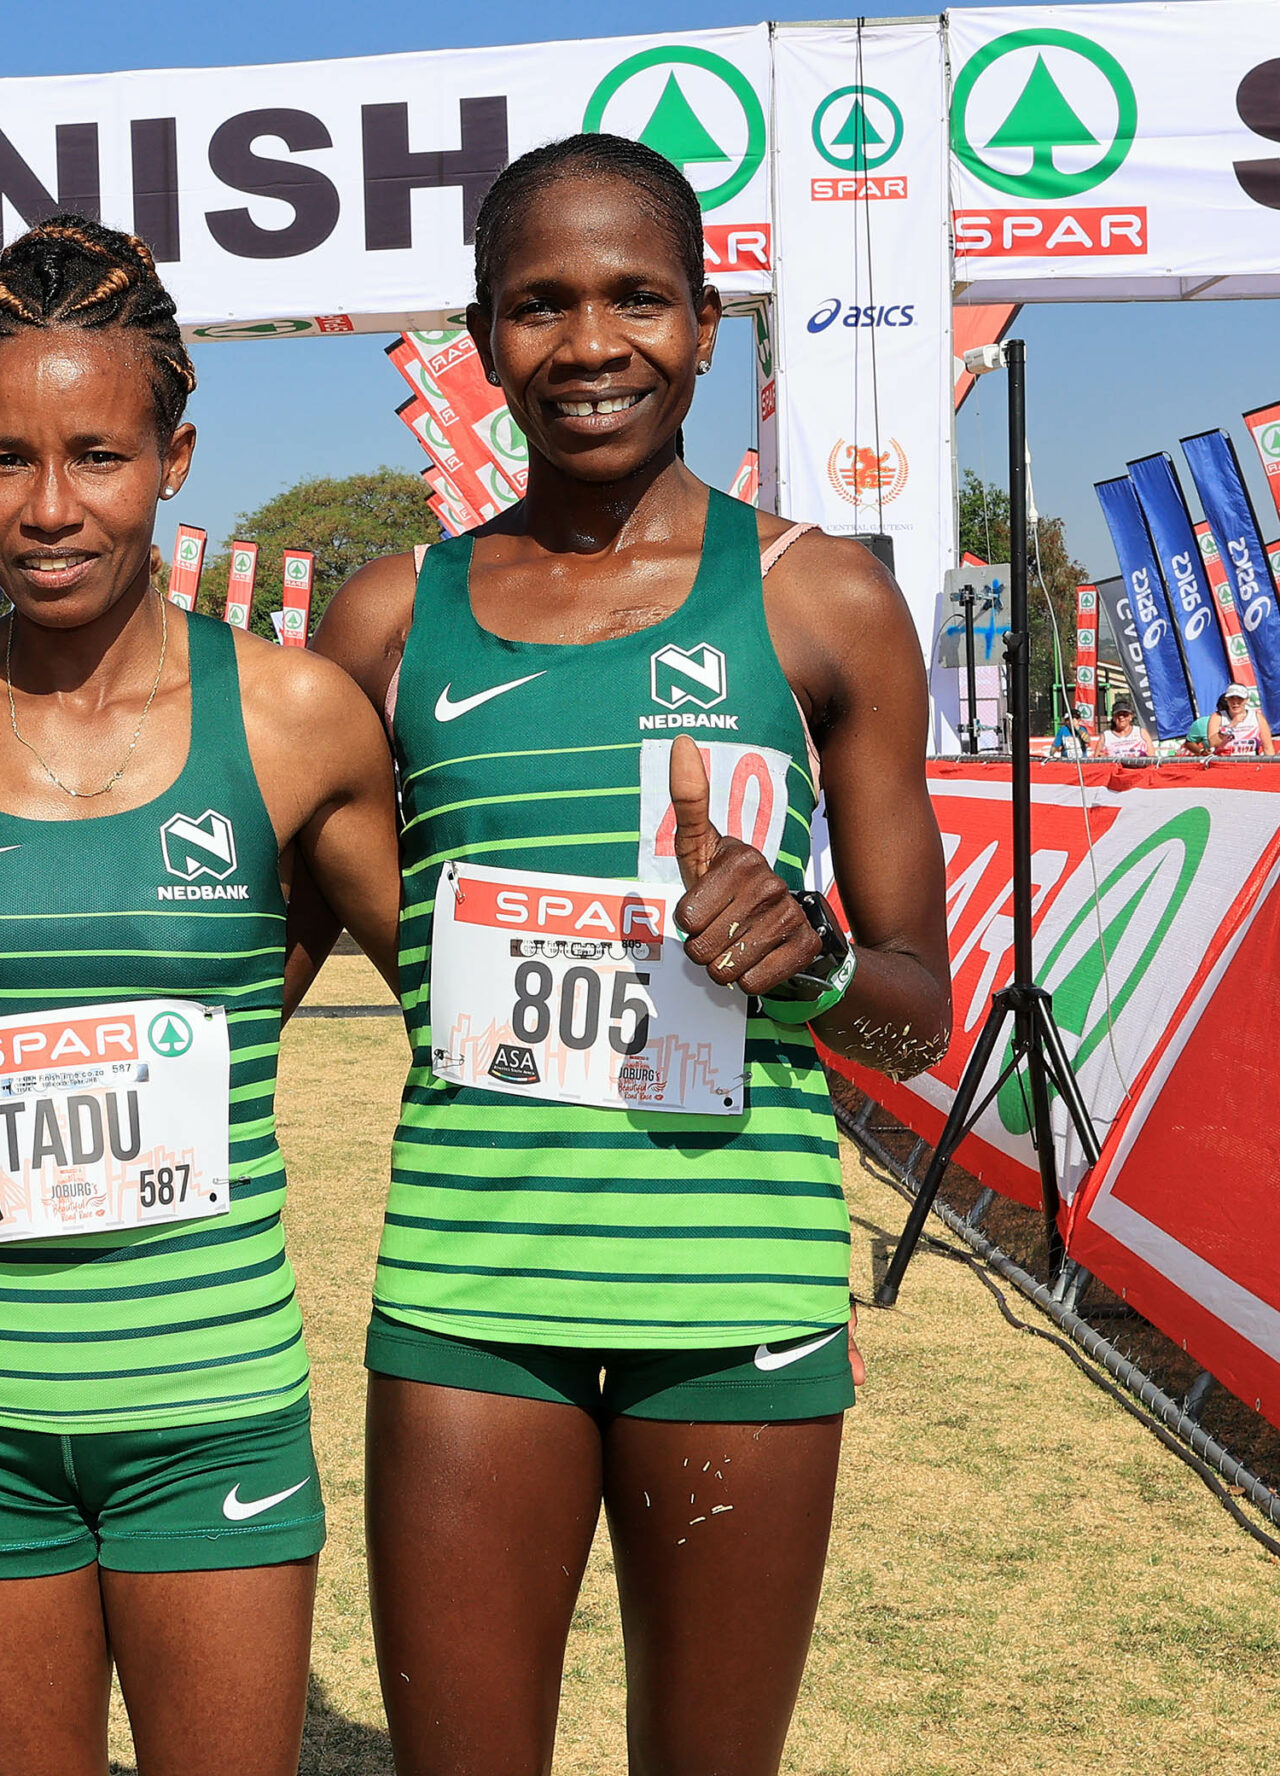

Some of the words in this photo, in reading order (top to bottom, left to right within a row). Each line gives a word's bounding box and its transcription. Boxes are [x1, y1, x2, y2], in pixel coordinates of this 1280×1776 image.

[813, 179, 906, 199] SPAR
[955, 214, 1144, 251] SPAR
[639, 714, 738, 731] NEDBANK
[158, 885, 250, 901] NEDBANK
[496, 891, 662, 937] SPAR
[512, 960, 652, 1056] 805
[495, 1048, 534, 1070] ASA
[140, 1164, 191, 1208] 587
